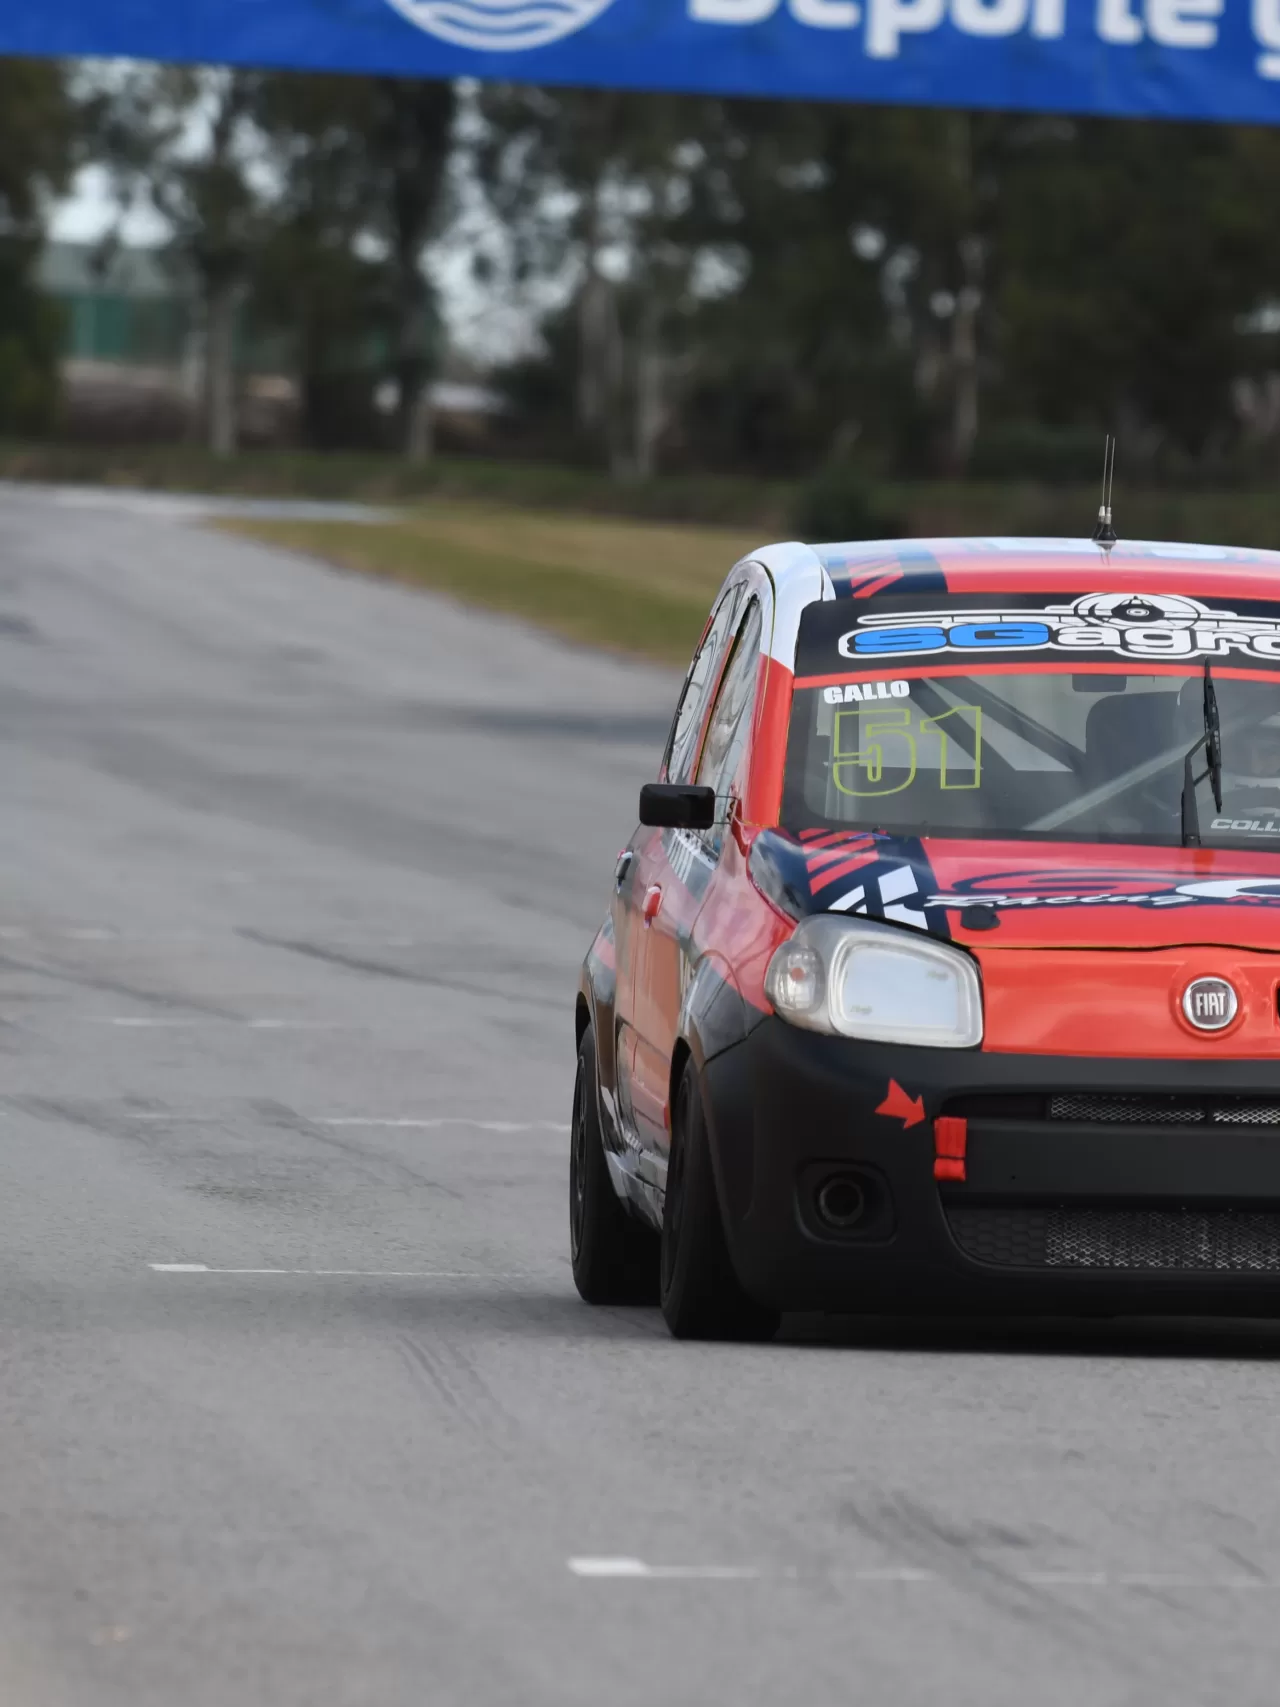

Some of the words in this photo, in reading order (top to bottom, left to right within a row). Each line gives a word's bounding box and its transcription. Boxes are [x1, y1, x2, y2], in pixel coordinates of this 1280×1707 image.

[823, 680, 910, 705] GALLO
[832, 705, 982, 797] 51
[1195, 992, 1226, 1016] FIAT
